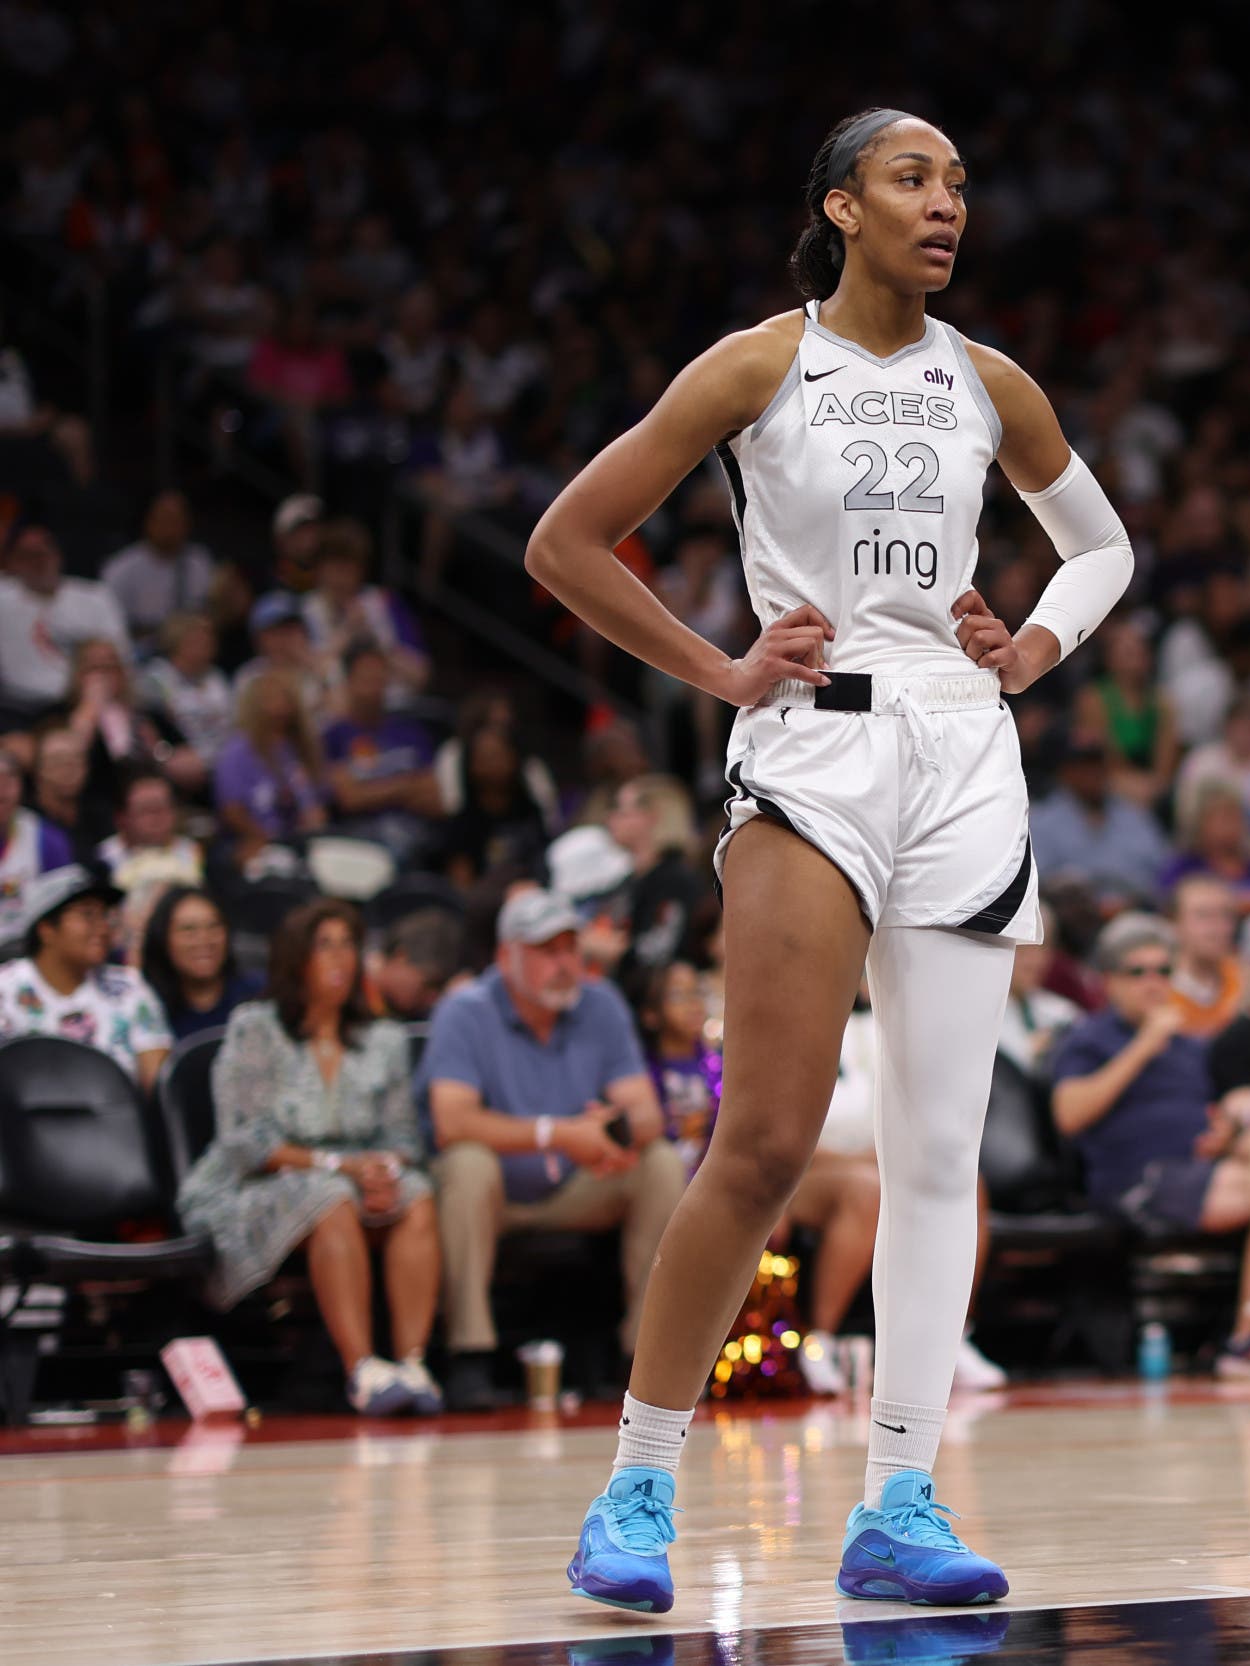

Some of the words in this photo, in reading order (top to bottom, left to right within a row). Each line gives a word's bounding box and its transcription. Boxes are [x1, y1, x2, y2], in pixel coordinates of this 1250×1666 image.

[923, 367, 955, 391] ally
[810, 390, 958, 431] ACES
[841, 439, 944, 514] 22
[853, 528, 938, 590] ring
